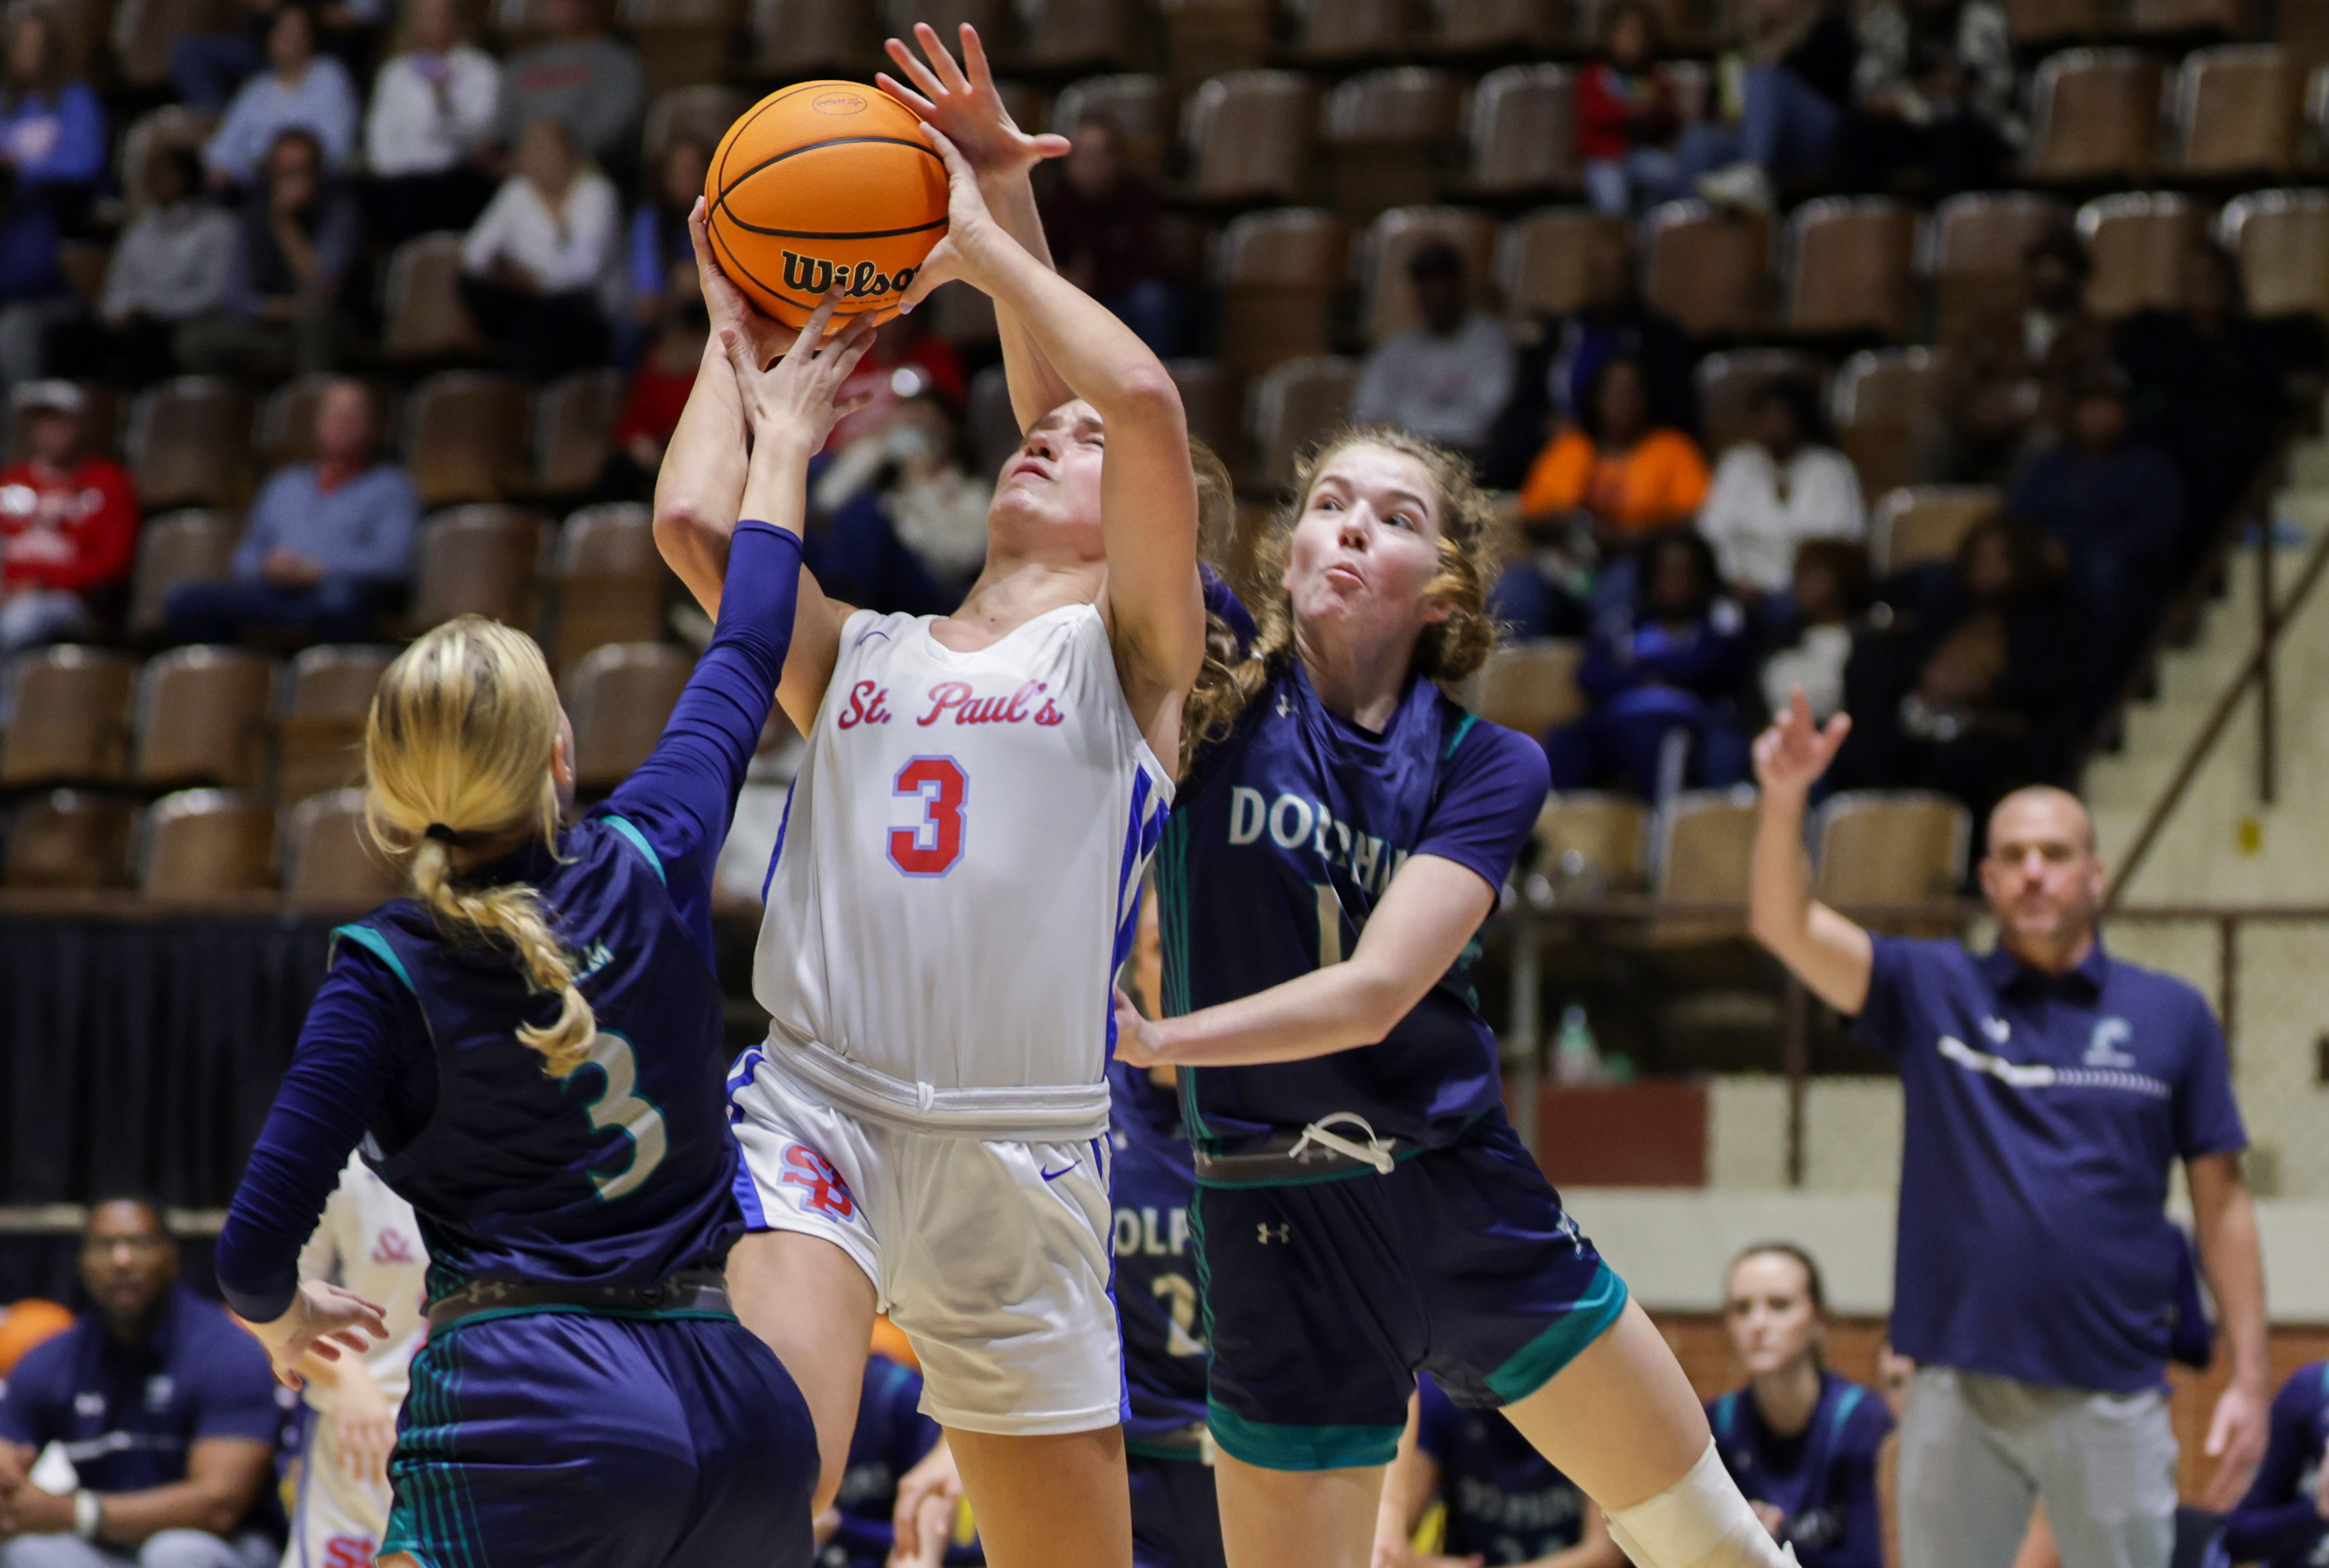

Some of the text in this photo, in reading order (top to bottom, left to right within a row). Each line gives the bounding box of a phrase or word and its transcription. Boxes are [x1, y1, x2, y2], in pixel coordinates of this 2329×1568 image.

[781, 249, 923, 297] Wilso
[838, 679, 1064, 730] St. Paul's
[885, 754, 970, 878] 3
[562, 1028, 668, 1202] 3
[1114, 1206, 1192, 1257] OLP
